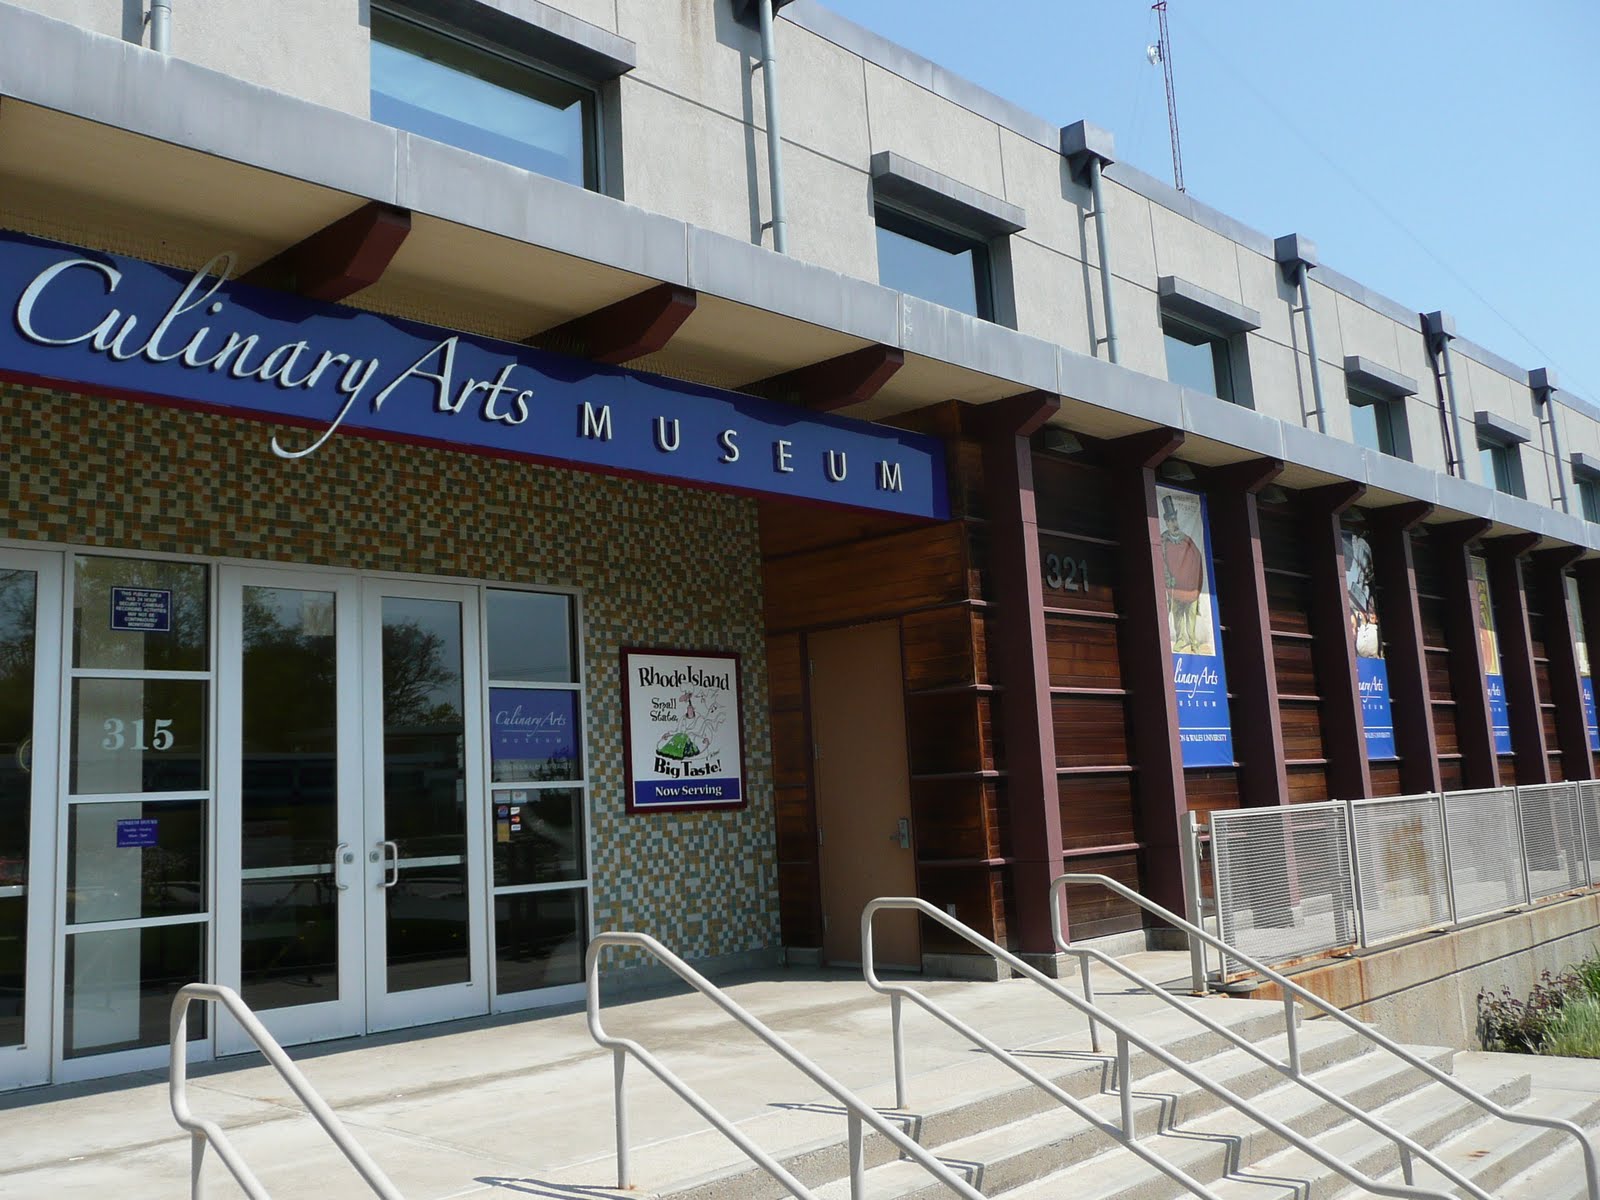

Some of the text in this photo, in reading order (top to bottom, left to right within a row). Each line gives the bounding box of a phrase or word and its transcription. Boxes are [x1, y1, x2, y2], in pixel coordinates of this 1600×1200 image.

[16, 250, 903, 492] Culinary Arts MUSEUM
[1046, 553, 1089, 592] 321
[638, 665, 730, 691] Rhode Island
[1174, 657, 1218, 699] linary Arts
[651, 697, 677, 712] Small
[103, 718, 175, 751] 315
[495, 704, 567, 737] Culinary Arts
[1189, 734, 1204, 742] WALES
[1204, 734, 1227, 742] UNIVERSITY
[653, 757, 722, 779] Big Taste!
[655, 783, 723, 797] Now Serving
